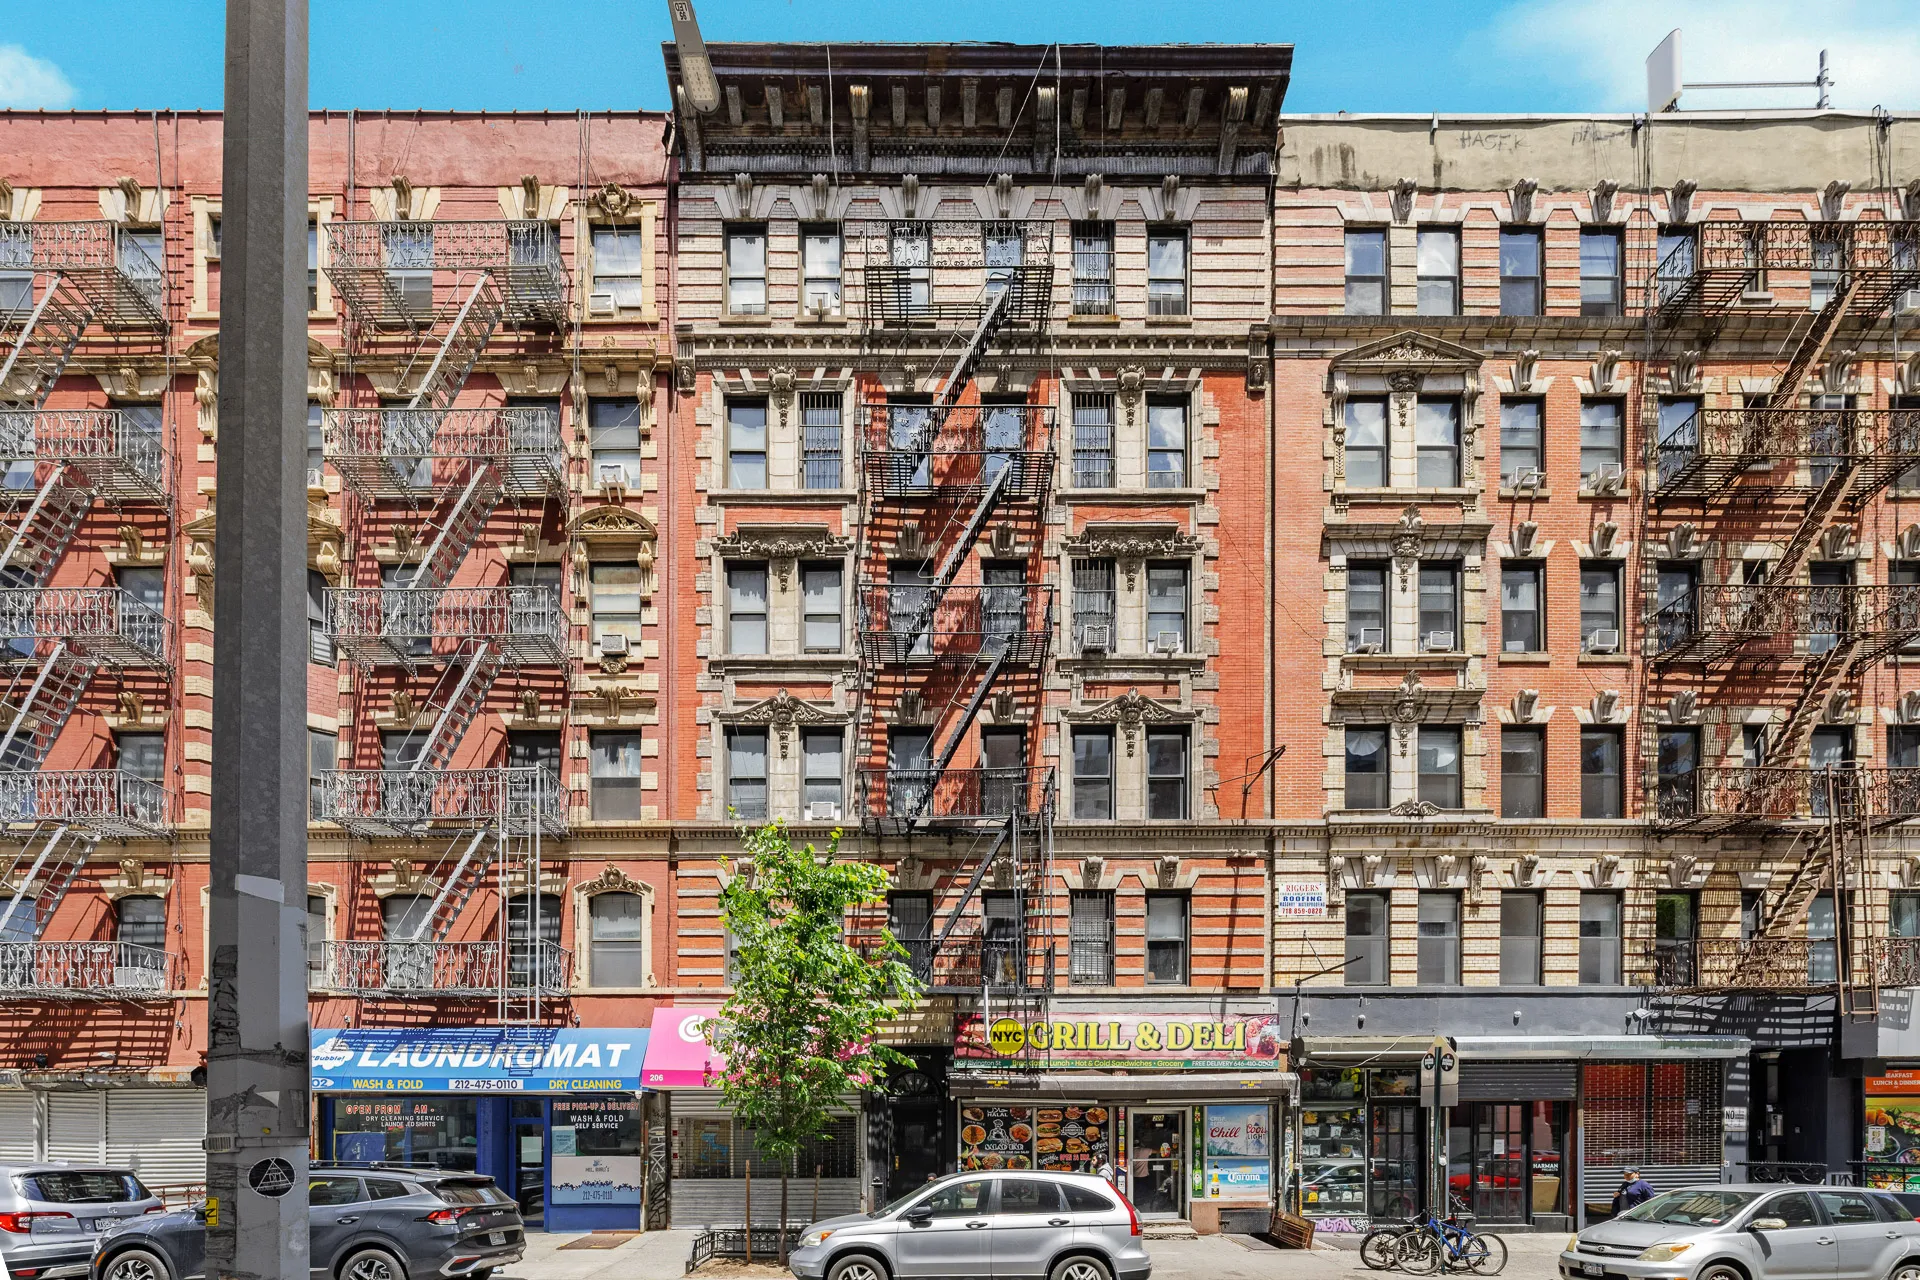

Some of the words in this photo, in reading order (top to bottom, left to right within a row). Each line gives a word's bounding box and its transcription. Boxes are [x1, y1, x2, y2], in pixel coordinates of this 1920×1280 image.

[1286, 884, 1319, 892] RIGGERS
[992, 1031, 1022, 1043] NYC
[1028, 1021, 1131, 1051] GRILL
[1134, 1021, 1163, 1051] &
[1166, 1021, 1247, 1051] DELI
[357, 1043, 631, 1068] LAUNDROMAT
[1156, 1060, 1184, 1068] Grocery
[312, 1079, 327, 1087] 02
[649, 1074, 664, 1082] 206
[352, 1079, 383, 1089] WASH
[386, 1079, 395, 1089] &
[397, 1079, 424, 1089] FOLD
[454, 1079, 518, 1089] 212-475-0110
[549, 1079, 568, 1090] DRY
[571, 1079, 622, 1090] CLEANING
[345, 1104, 372, 1114] OPEN
[374, 1104, 401, 1114] FROM
[413, 1104, 428, 1114] AM
[553, 1102, 570, 1111] FREE
[571, 1102, 598, 1111] PICK-UP
[607, 1102, 640, 1111] DELIVERY
[570, 1114, 593, 1123] WASH
[595, 1114, 601, 1123] &
[603, 1114, 624, 1122] FOLD
[1725, 1110, 1735, 1120] NO
[1210, 1127, 1241, 1138] Chill
[1246, 1124, 1268, 1134] Coors
[984, 1143, 1008, 1151] SALAD
[1059, 1153, 1073, 1161] OPEN
[1227, 1173, 1261, 1183] Corona
